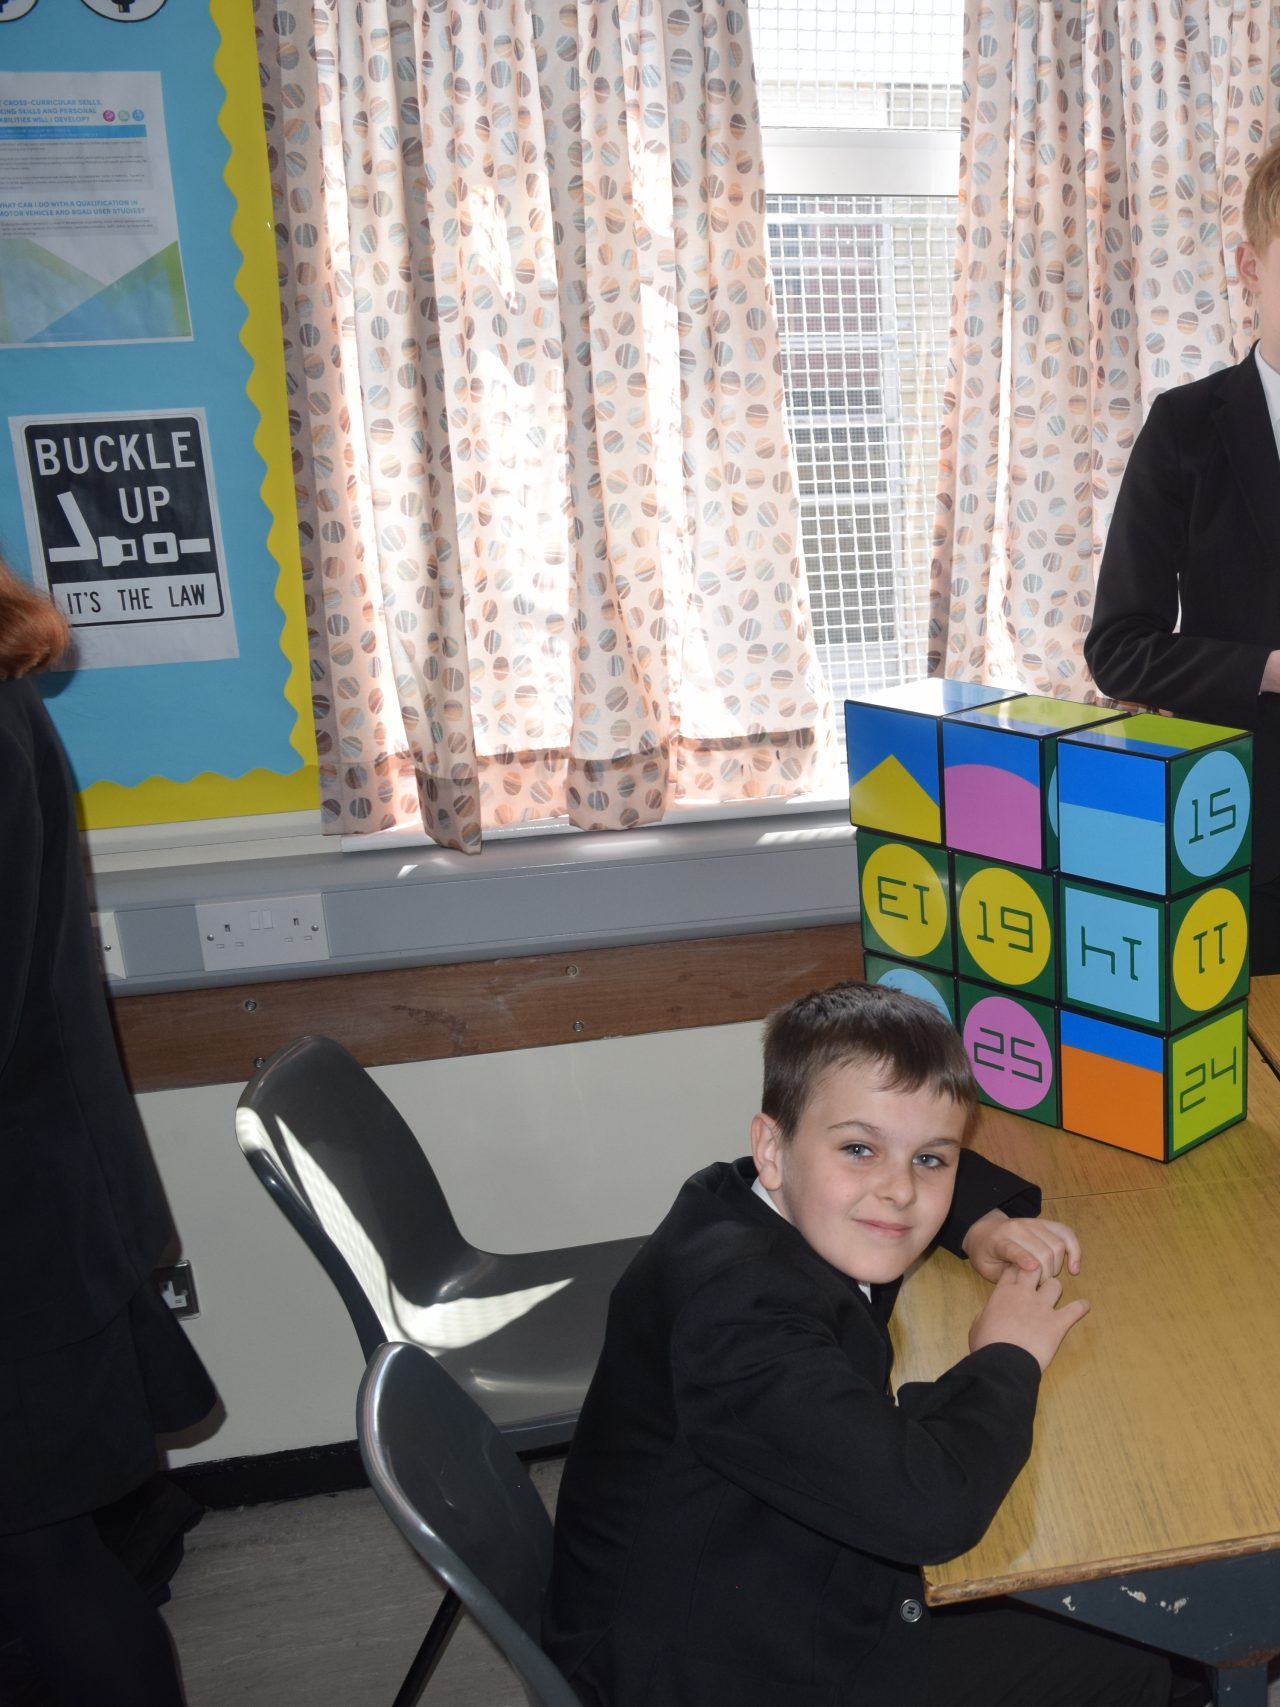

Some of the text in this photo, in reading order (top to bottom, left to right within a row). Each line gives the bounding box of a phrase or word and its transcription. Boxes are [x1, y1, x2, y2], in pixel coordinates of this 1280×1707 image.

[34, 431, 196, 476] BUCKLE
[118, 485, 171, 524] UP
[66, 583, 206, 615] IT'S THE LAW
[1188, 787, 1237, 844] 15
[976, 900, 1034, 953] 19
[973, 1026, 1043, 1083] 25
[1179, 1045, 1237, 1114] 24
